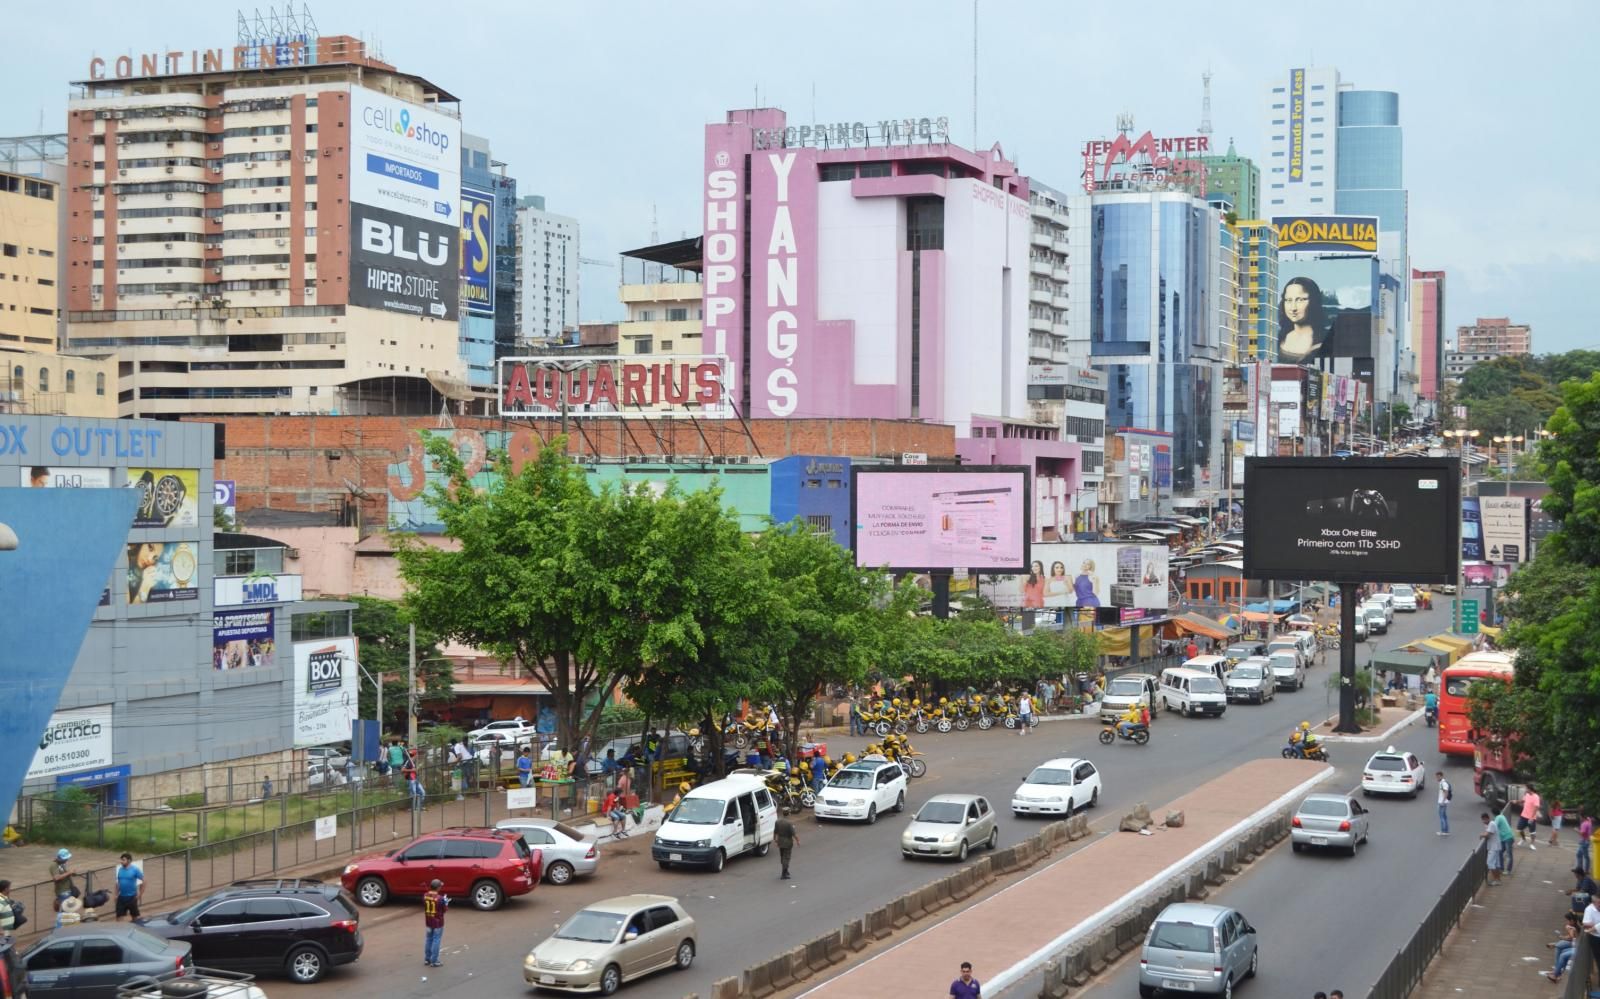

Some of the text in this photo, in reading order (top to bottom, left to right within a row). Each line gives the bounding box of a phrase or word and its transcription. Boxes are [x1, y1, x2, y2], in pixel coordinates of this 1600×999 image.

[1291, 70, 1304, 166] Brands For Less
[416, 122, 449, 154] shop
[385, 162, 422, 182] IMPORTADOS
[367, 267, 440, 301] HIPER STORE
[506, 363, 722, 411] AQUARIUS
[51, 425, 162, 458] OUTLET
[1297, 538, 1335, 548] Primeiro
[1336, 541, 1356, 549] com
[1376, 540, 1401, 549] SSHD
[1321, 528, 1378, 537] Xbox One Elite
[311, 658, 341, 681] BOX
[44, 749, 90, 764] 061-510300
[426, 900, 436, 914] 11
